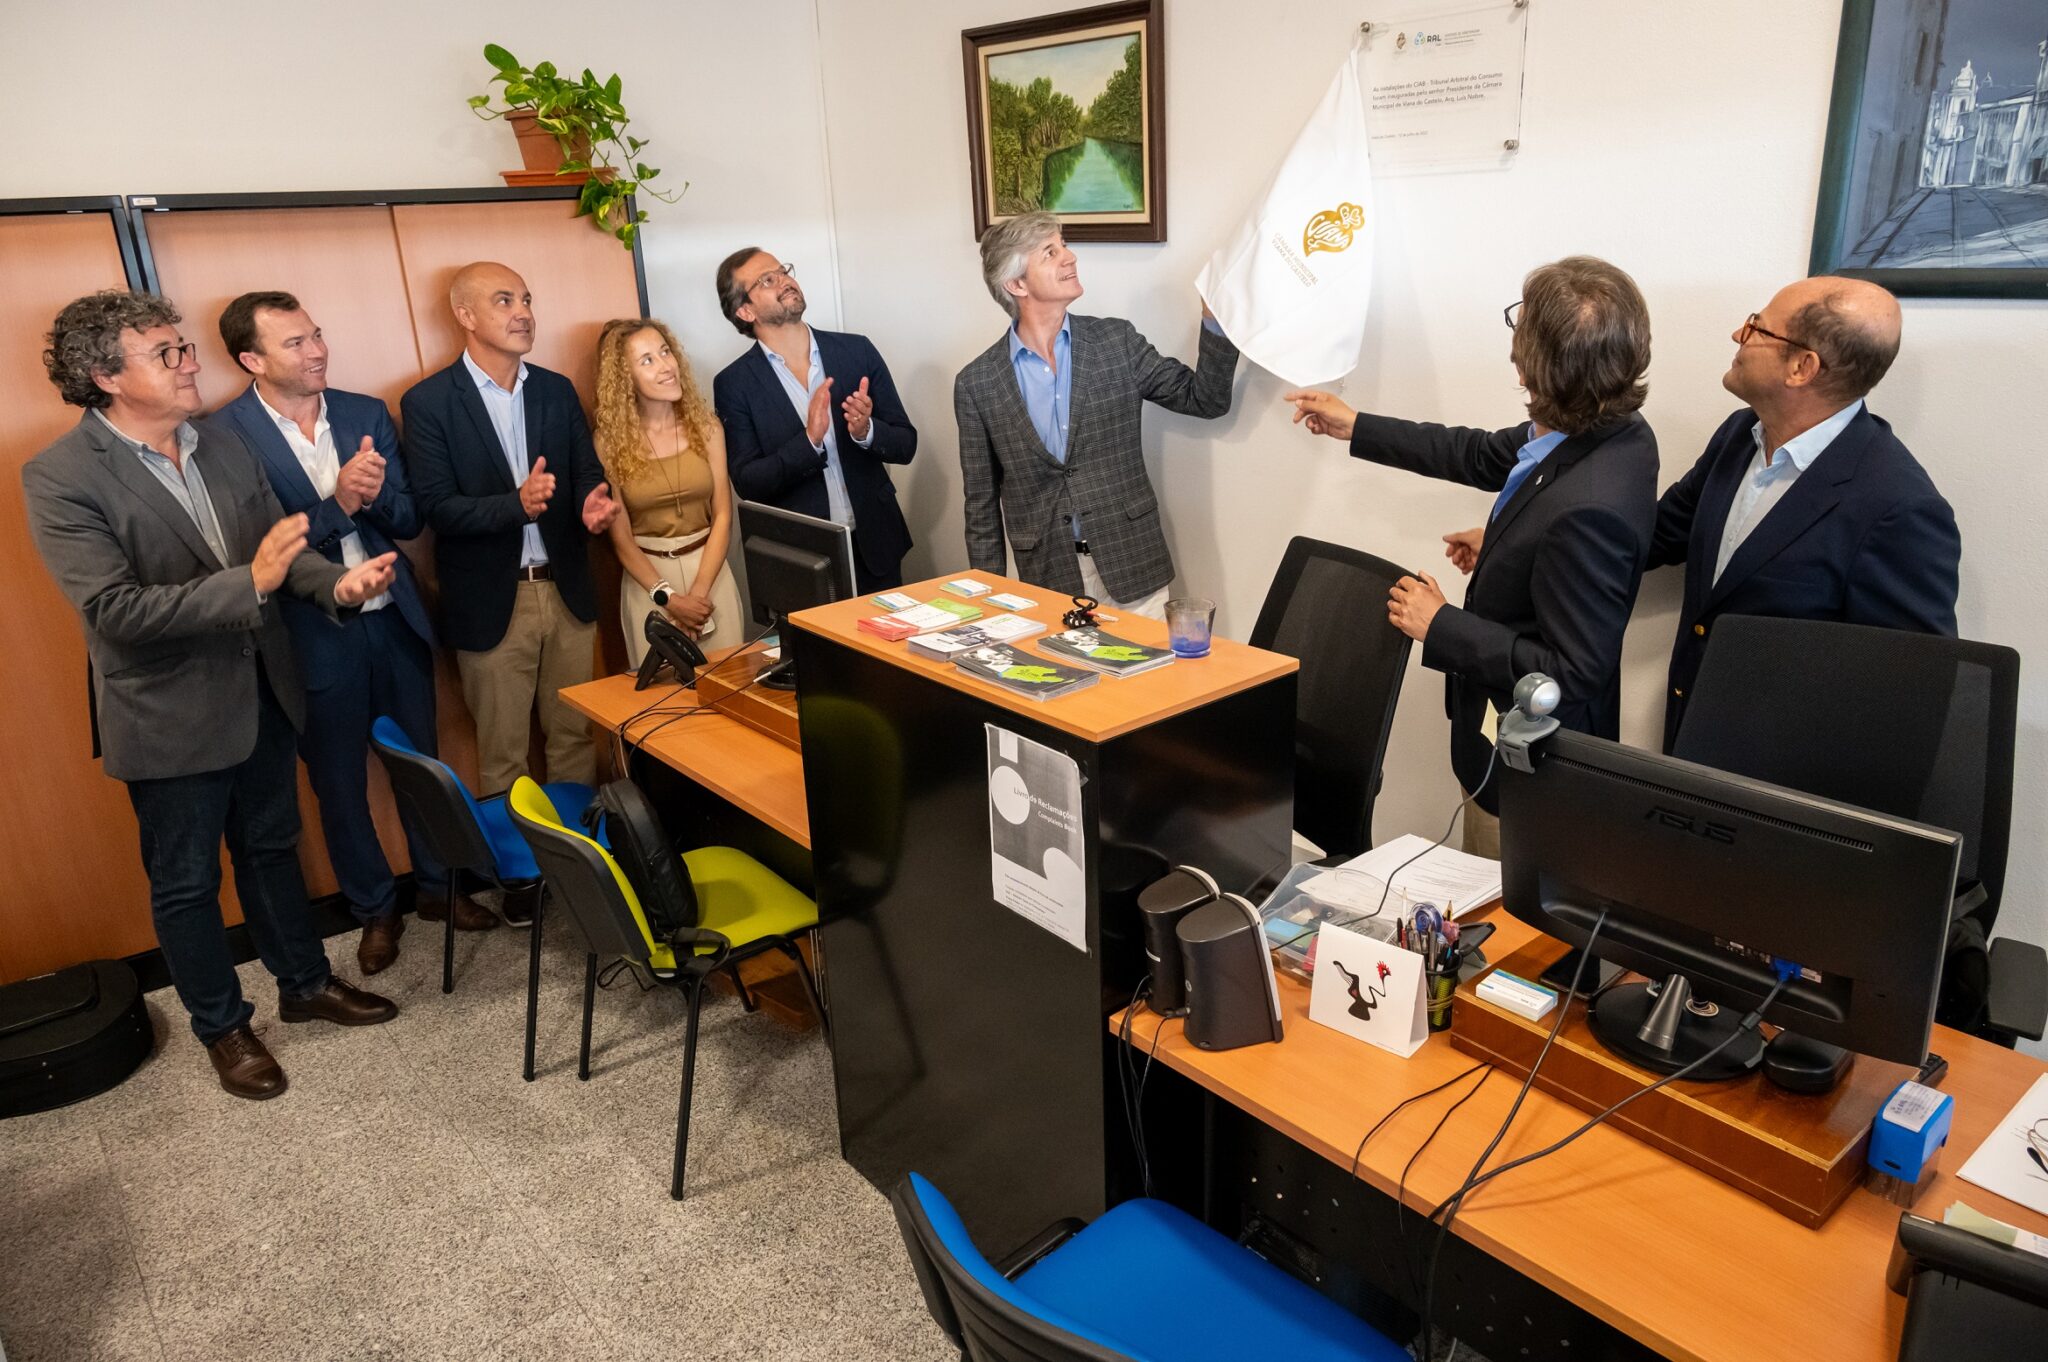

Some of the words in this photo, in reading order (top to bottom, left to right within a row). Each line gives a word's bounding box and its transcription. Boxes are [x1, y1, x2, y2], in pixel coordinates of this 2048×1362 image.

[1430, 77, 1450, 86] Tribunal
[1446, 84, 1473, 92] Presidente
[1373, 102, 1395, 110] Municipal
[1013, 786, 1030, 800] Livro
[1029, 794, 1038, 804] de
[1038, 797, 1078, 823] Reclamações
[1644, 805, 1738, 845] ASUS
